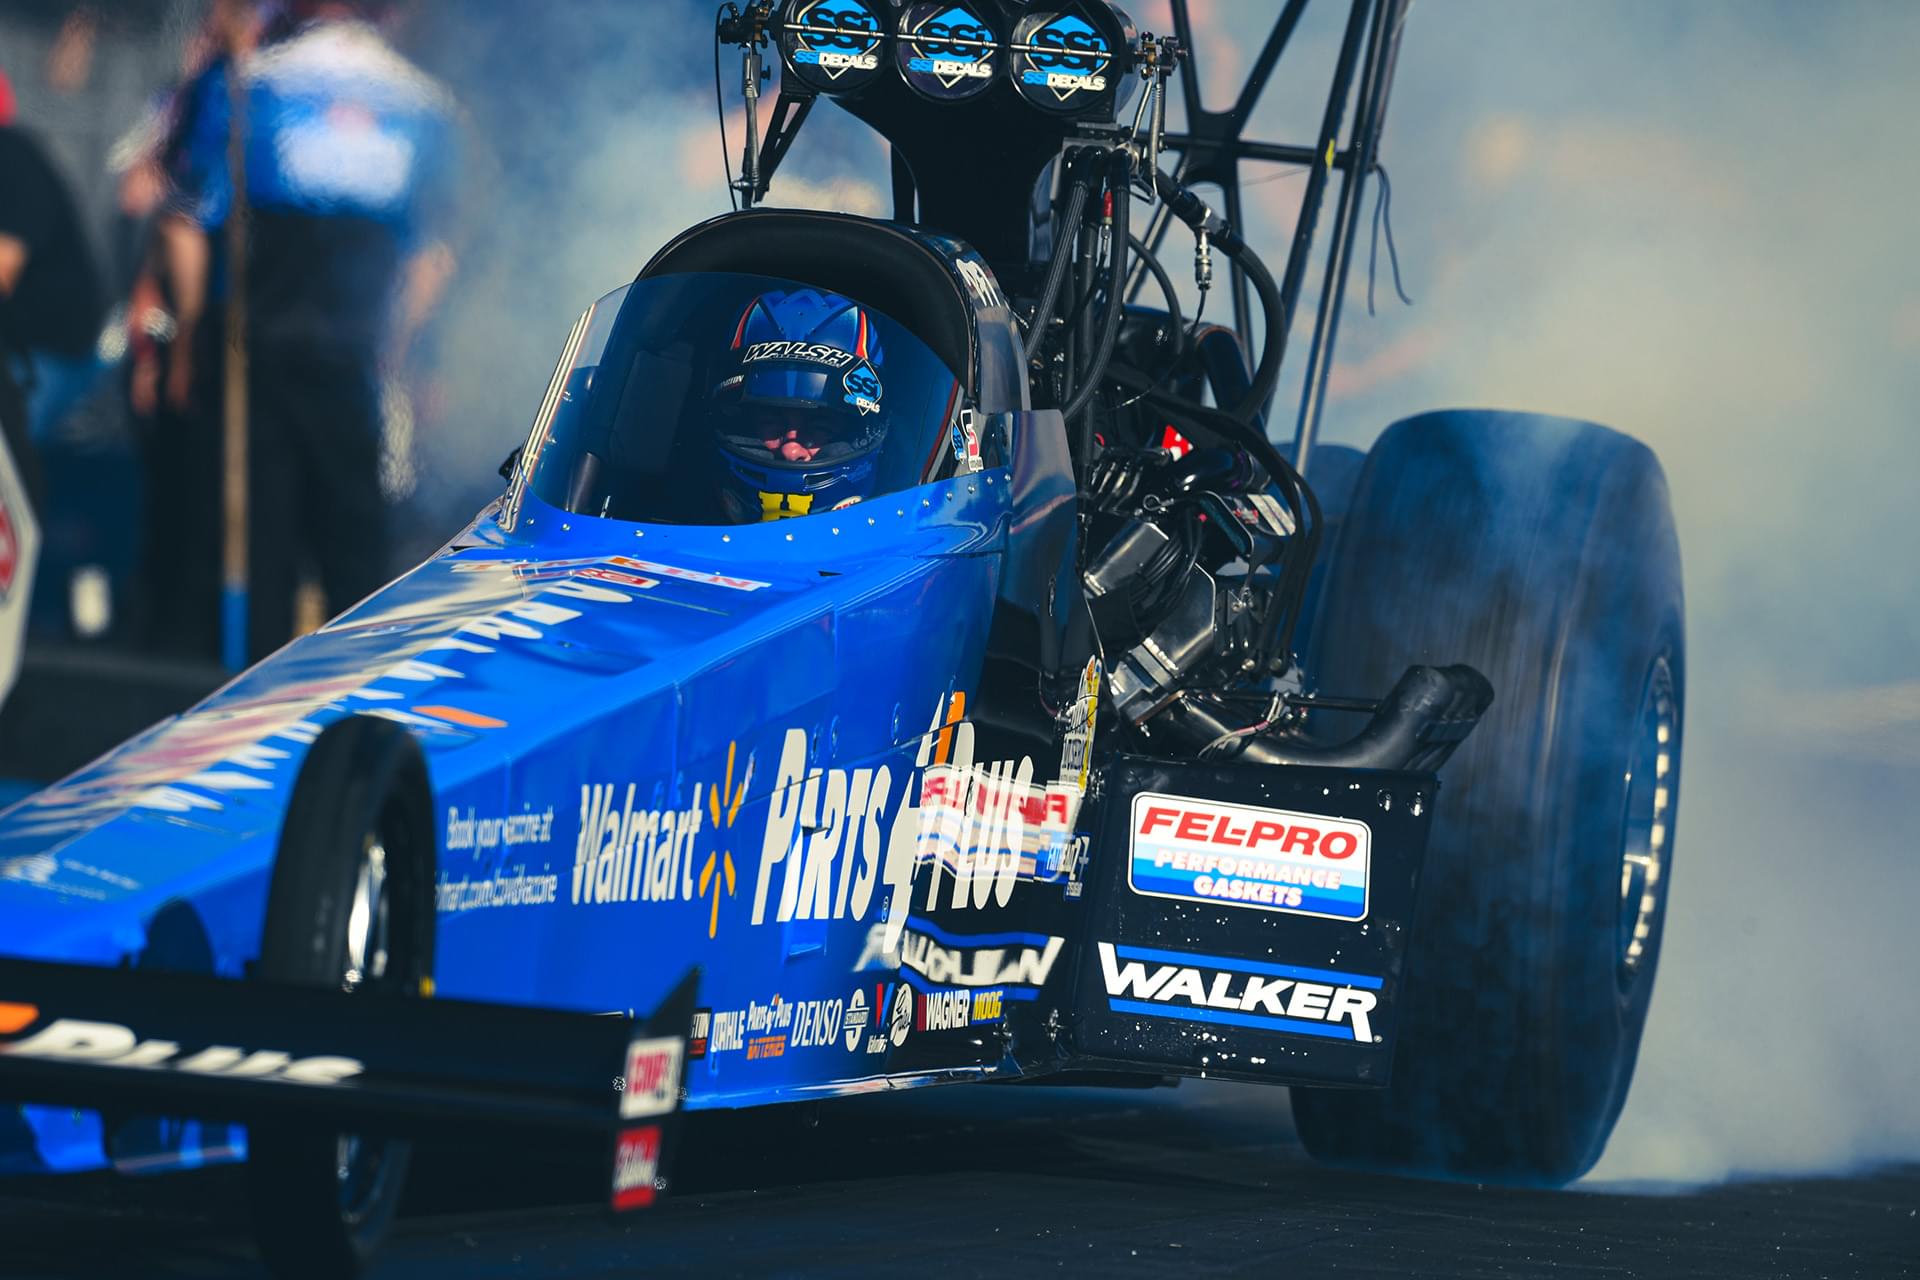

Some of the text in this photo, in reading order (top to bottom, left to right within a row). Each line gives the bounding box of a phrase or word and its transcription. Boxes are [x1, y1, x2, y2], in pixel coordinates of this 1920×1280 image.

[743, 341, 854, 368] WALSH
[572, 782, 703, 905] Walmart
[1139, 806, 1358, 860] FEL-PRO
[1154, 848, 1342, 891] PERFORMANCE
[1193, 875, 1303, 907] GASKETS
[925, 989, 970, 1032] WAGNER
[1097, 941, 1379, 1044] WALKER
[790, 998, 843, 1048] DENSO
